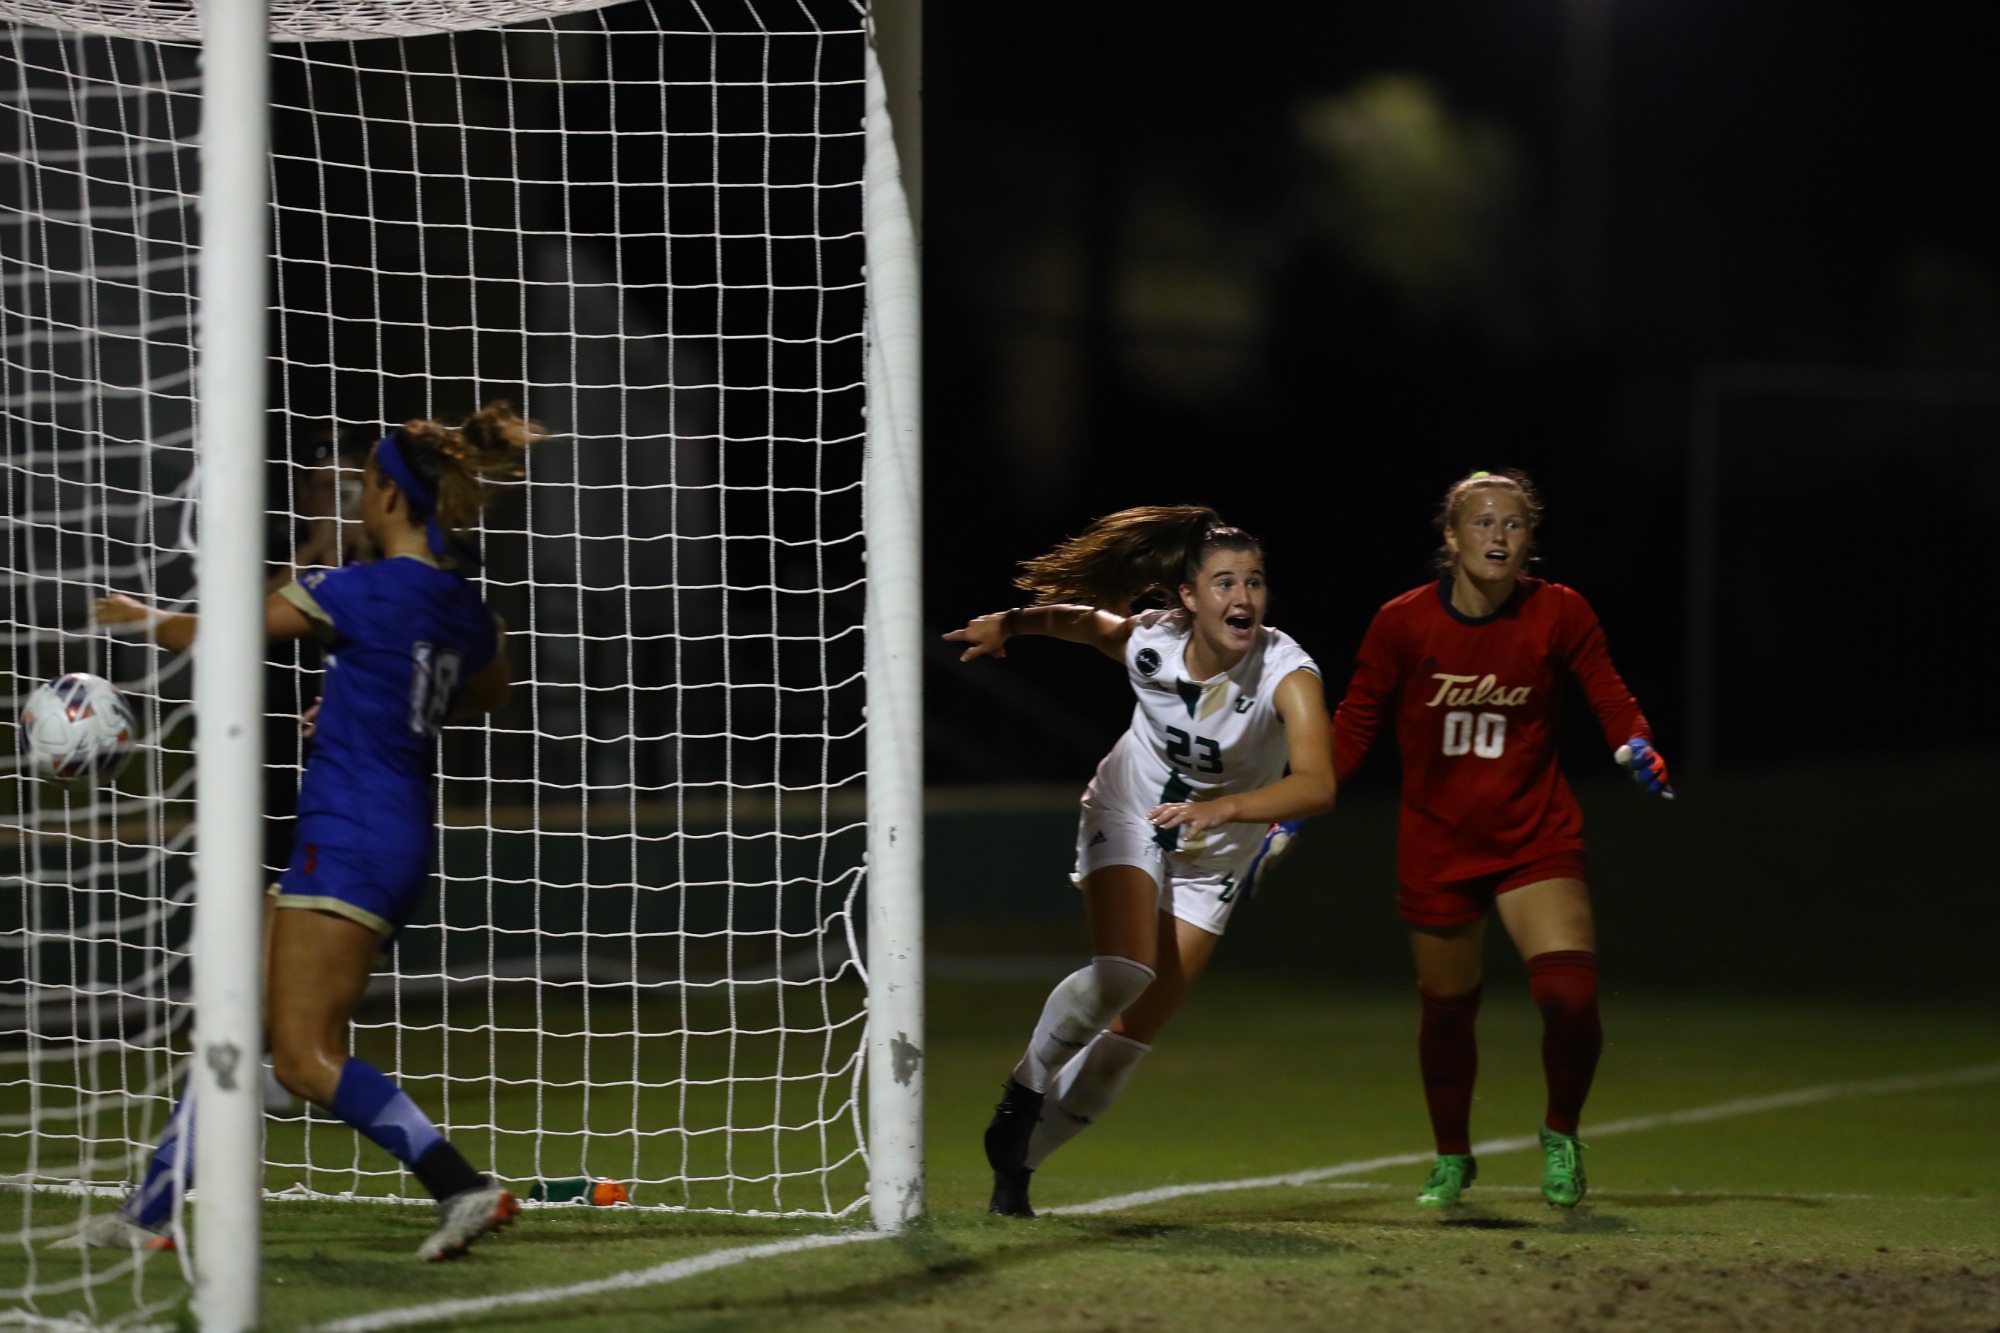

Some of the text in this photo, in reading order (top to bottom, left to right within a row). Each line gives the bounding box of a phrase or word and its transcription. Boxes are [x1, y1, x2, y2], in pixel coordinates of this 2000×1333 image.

[410, 641, 461, 736] 18
[1425, 673, 1532, 707] Tulsa
[1166, 725, 1223, 774] 23
[1442, 711, 1507, 759] 00
